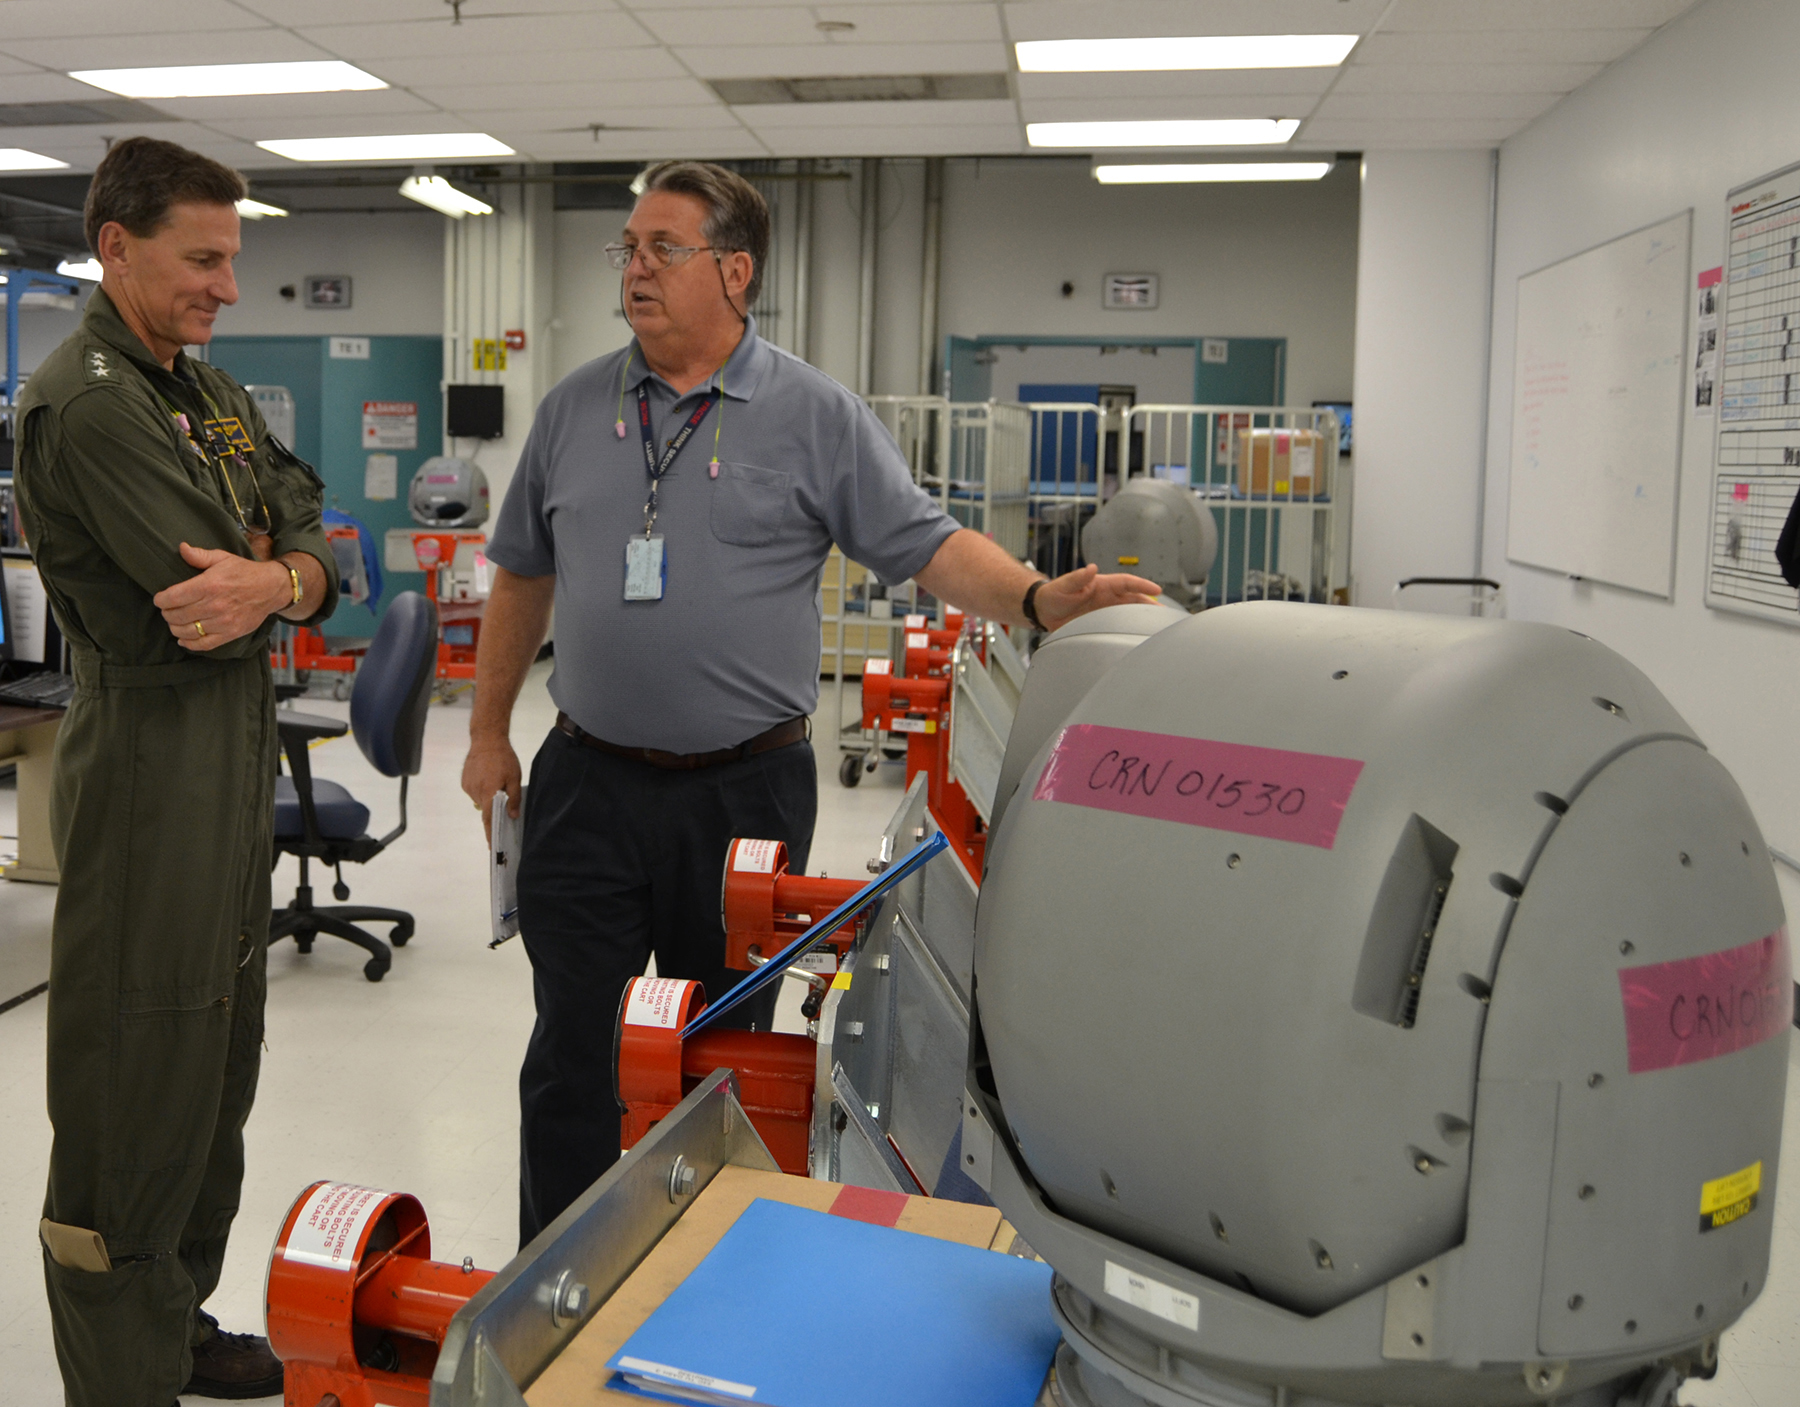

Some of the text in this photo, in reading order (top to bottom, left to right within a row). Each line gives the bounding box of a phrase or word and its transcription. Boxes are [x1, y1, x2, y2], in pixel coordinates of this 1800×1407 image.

[673, 426, 693, 449] THINK
[1088, 750, 1305, 816] CRN 01530
[638, 988, 648, 1003] CART
[653, 995, 664, 1016] BOLTS
[661, 994, 673, 1025] SECURED
[1669, 984, 1735, 1041] CRN
[308, 1191, 335, 1227] THE CART
[318, 1217, 330, 1231] OR
[350, 1208, 360, 1216] IS
[1712, 1196, 1751, 1227] CAUTION
[323, 1217, 343, 1248] BOLTS
[331, 1217, 355, 1263] SECURED
